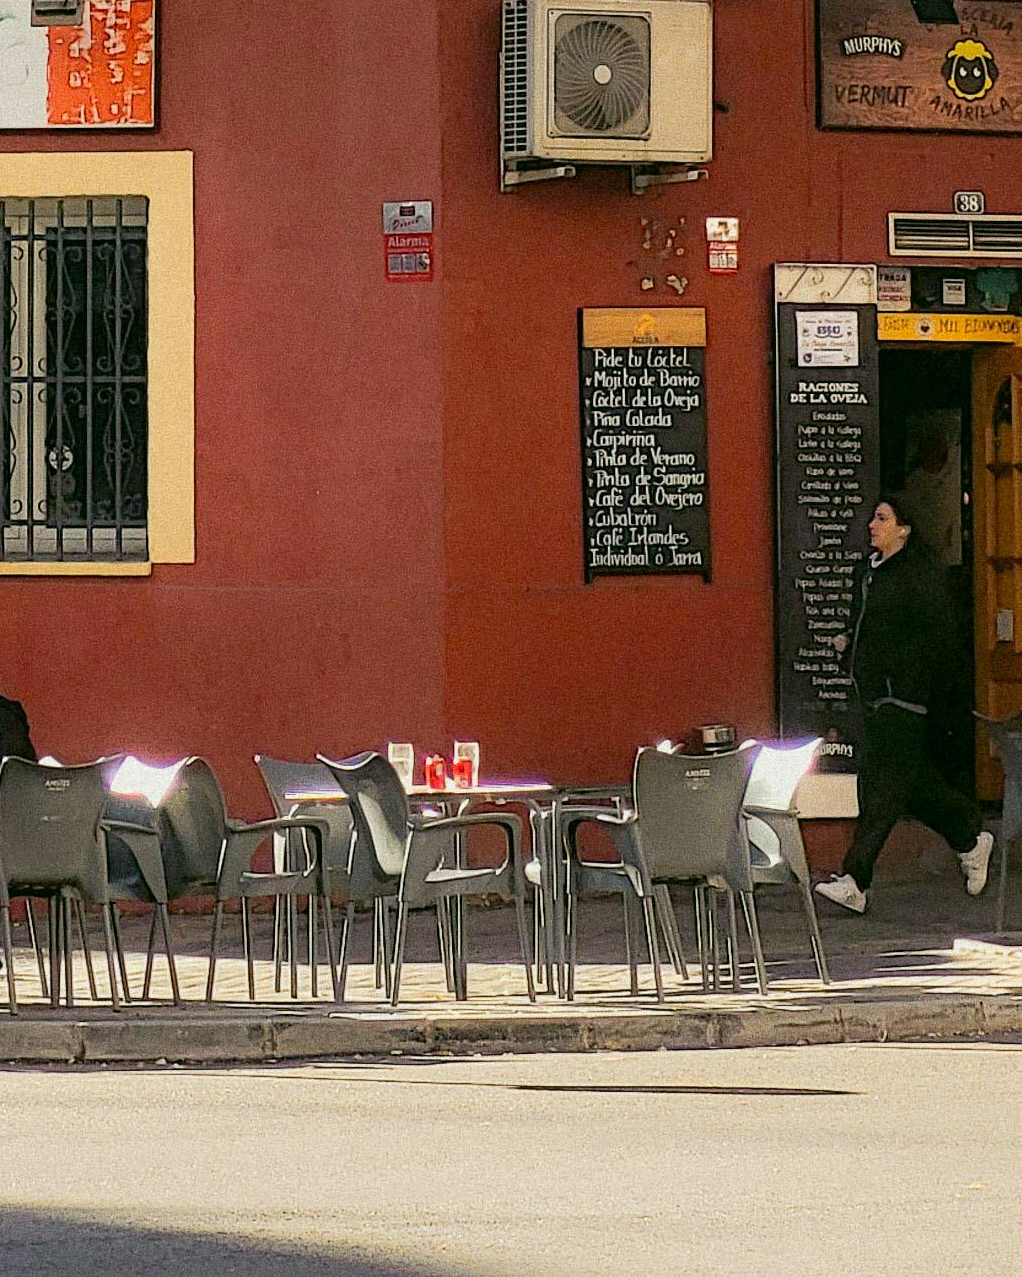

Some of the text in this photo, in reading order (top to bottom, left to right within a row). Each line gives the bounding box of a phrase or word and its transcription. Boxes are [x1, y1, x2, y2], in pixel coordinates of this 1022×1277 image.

[844, 36, 903, 58] MURPHYS
[835, 84, 913, 108] VERMUT
[960, 195, 978, 212] 38
[388, 236, 429, 247] Alarma
[593, 348, 623, 367] Pide
[628, 347, 642, 367] tu
[594, 367, 700, 391] Mojito de Barrio
[798, 382, 859, 392] RACIONES
[632, 389, 647, 407] de
[647, 388, 662, 407] la
[664, 388, 699, 412] Oveja
[790, 393, 868, 404] DE LA OVEJA
[626, 407, 672, 427] Colada
[594, 446, 695, 467] Pinta de Verano
[594, 467, 630, 488] Pinta
[636, 466, 651, 485] de
[595, 486, 703, 510] Café del Ovejero
[596, 528, 623, 546] Café
[820, 743, 854, 757] URPHYS
